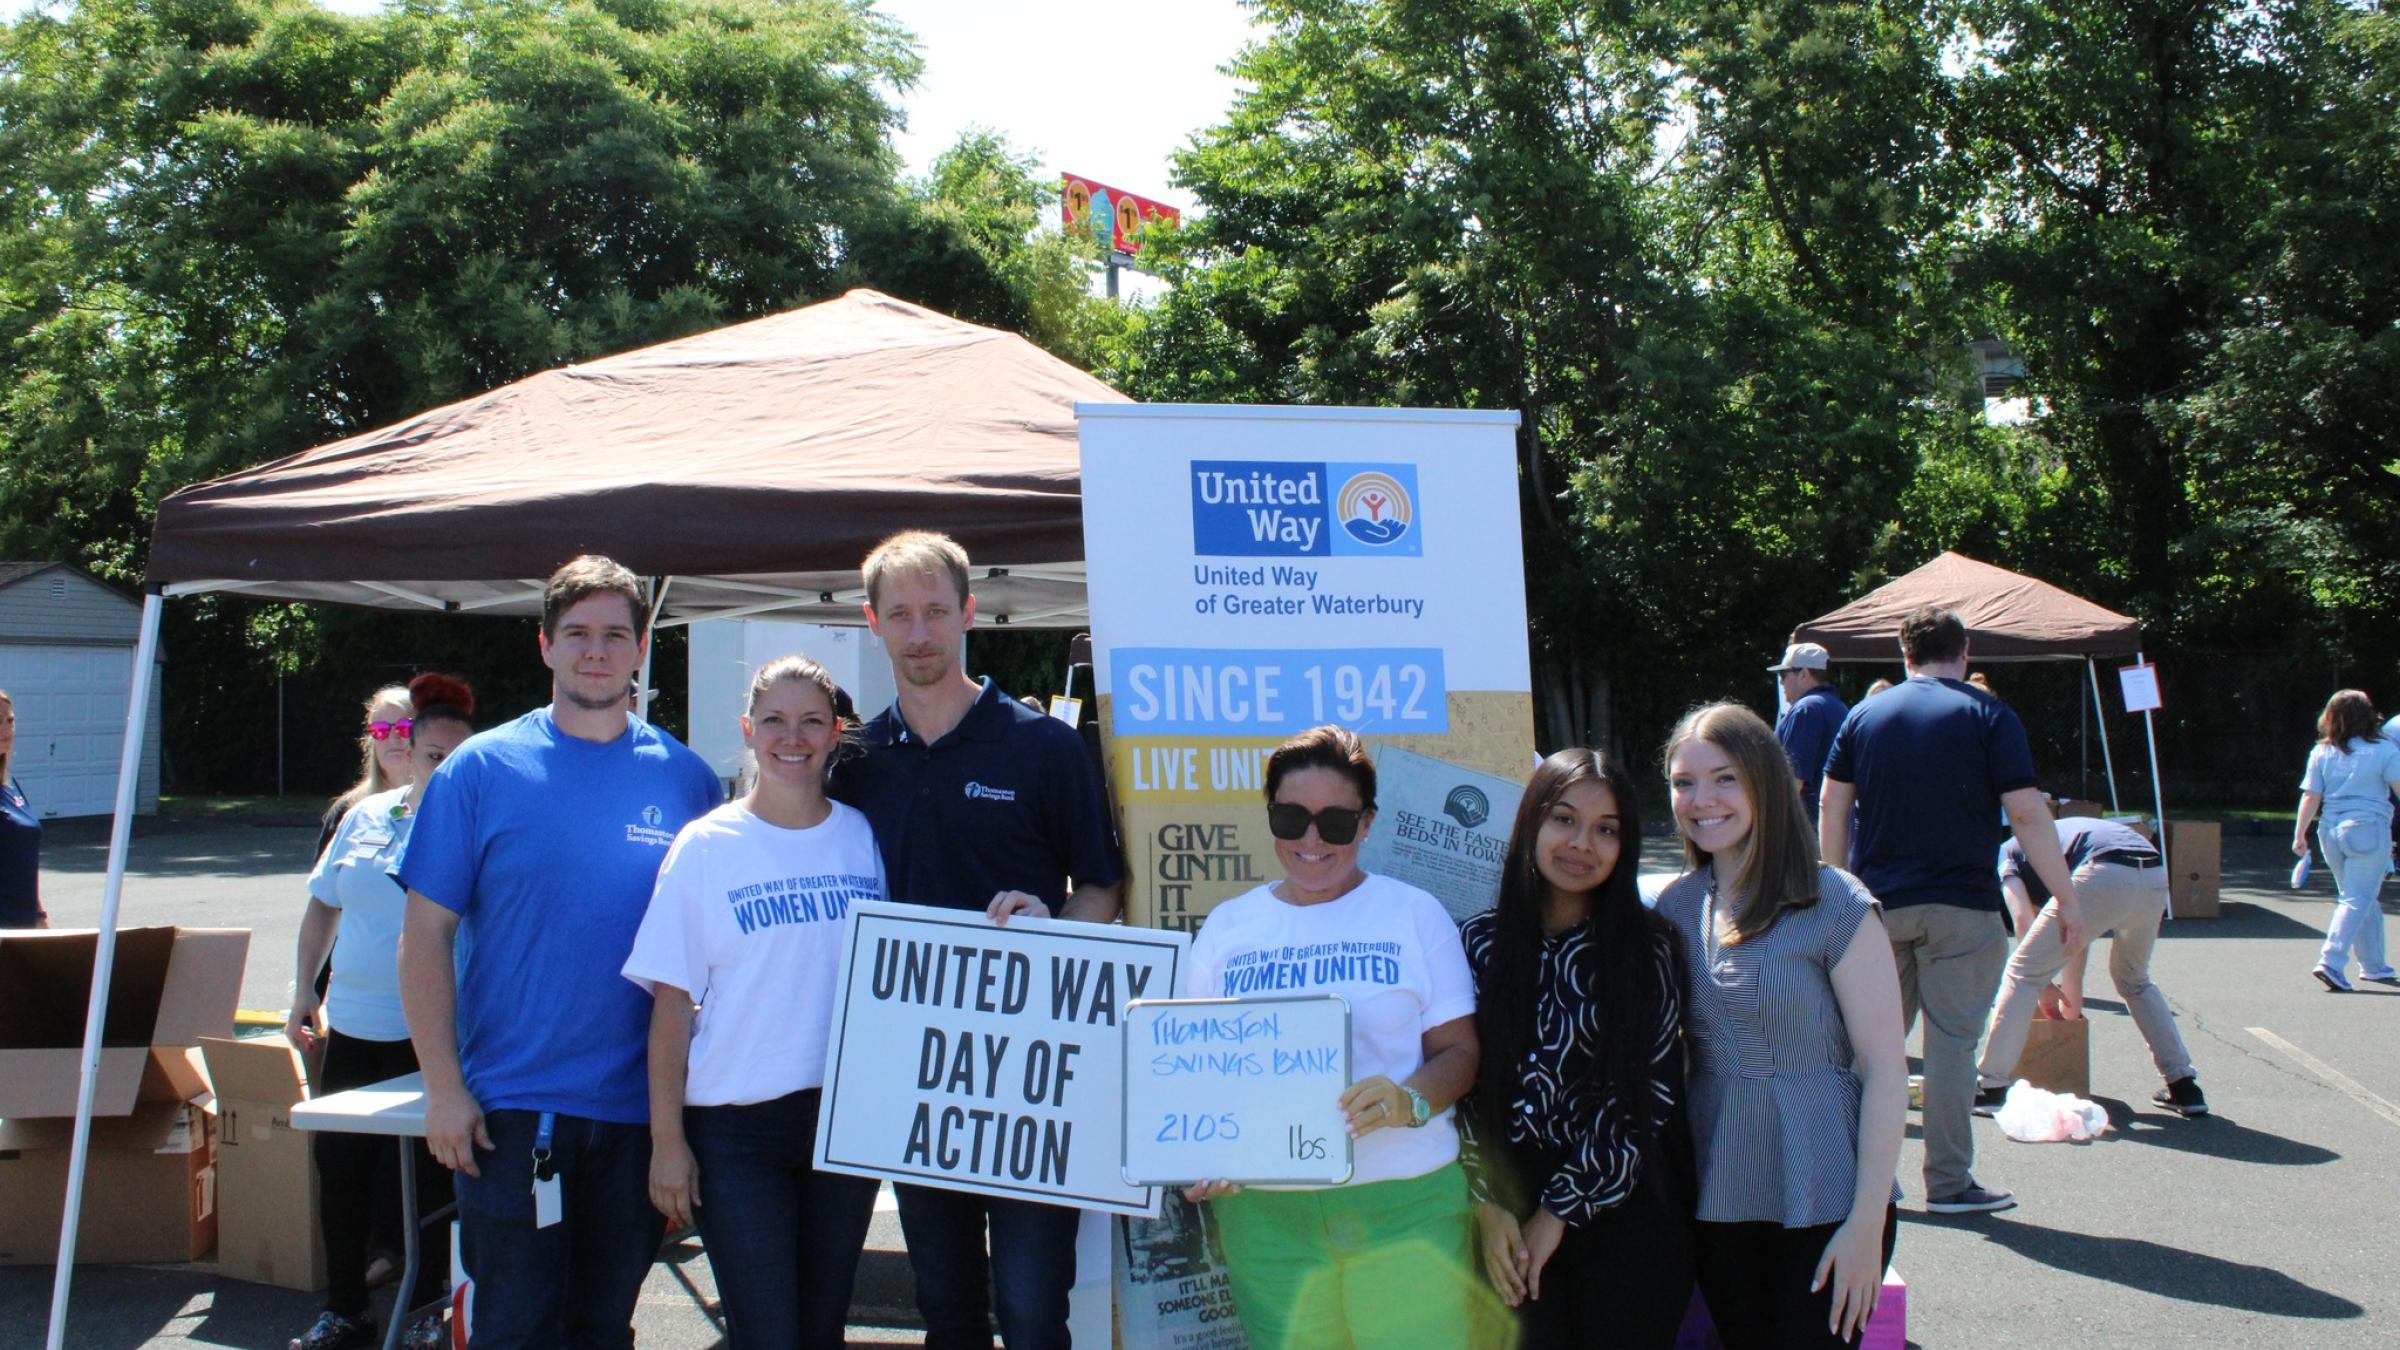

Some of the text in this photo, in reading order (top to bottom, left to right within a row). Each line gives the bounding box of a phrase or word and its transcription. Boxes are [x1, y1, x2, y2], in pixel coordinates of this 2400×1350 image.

[1198, 472, 1321, 505] United
[1247, 510, 1321, 551] Way
[1194, 565, 1318, 592] United Way
[1195, 595, 1424, 618] of Greater Waterbury
[1129, 664, 1428, 722] SINCE 1942
[1132, 747, 1277, 791] LIVE UNI
[627, 834, 657, 846] Savings
[1158, 824, 1240, 851] GIVE
[1396, 810, 1510, 853] SEE THE FASTE
[1397, 823, 1439, 846] BEDS
[1443, 837, 1460, 852] IN
[1159, 854, 1264, 882] UNTIL
[728, 874, 880, 904] UNITED WAY OF GREATER WATERBUR
[1160, 885, 1192, 912] IT
[734, 892, 819, 935] WOMEN
[1227, 951, 1257, 969] UNITED
[1282, 946, 1294, 961] OF
[1297, 943, 1340, 961] GREATER
[1341, 941, 1402, 957] WATERBURY
[872, 937, 1152, 1027] UNITED WAY
[1224, 954, 1399, 998] WOMEN UNITED
[1152, 1010, 1279, 1046] THOMASTON
[917, 1026, 1081, 1107] DAY OF
[1152, 1048, 1339, 1076] SAVINGS BANK
[1156, 1112, 1240, 1142] 2105
[903, 1102, 1072, 1186] ACTION
[1210, 1273, 1230, 1290] MA
[1158, 1289, 1232, 1316] SOMEONE EL
